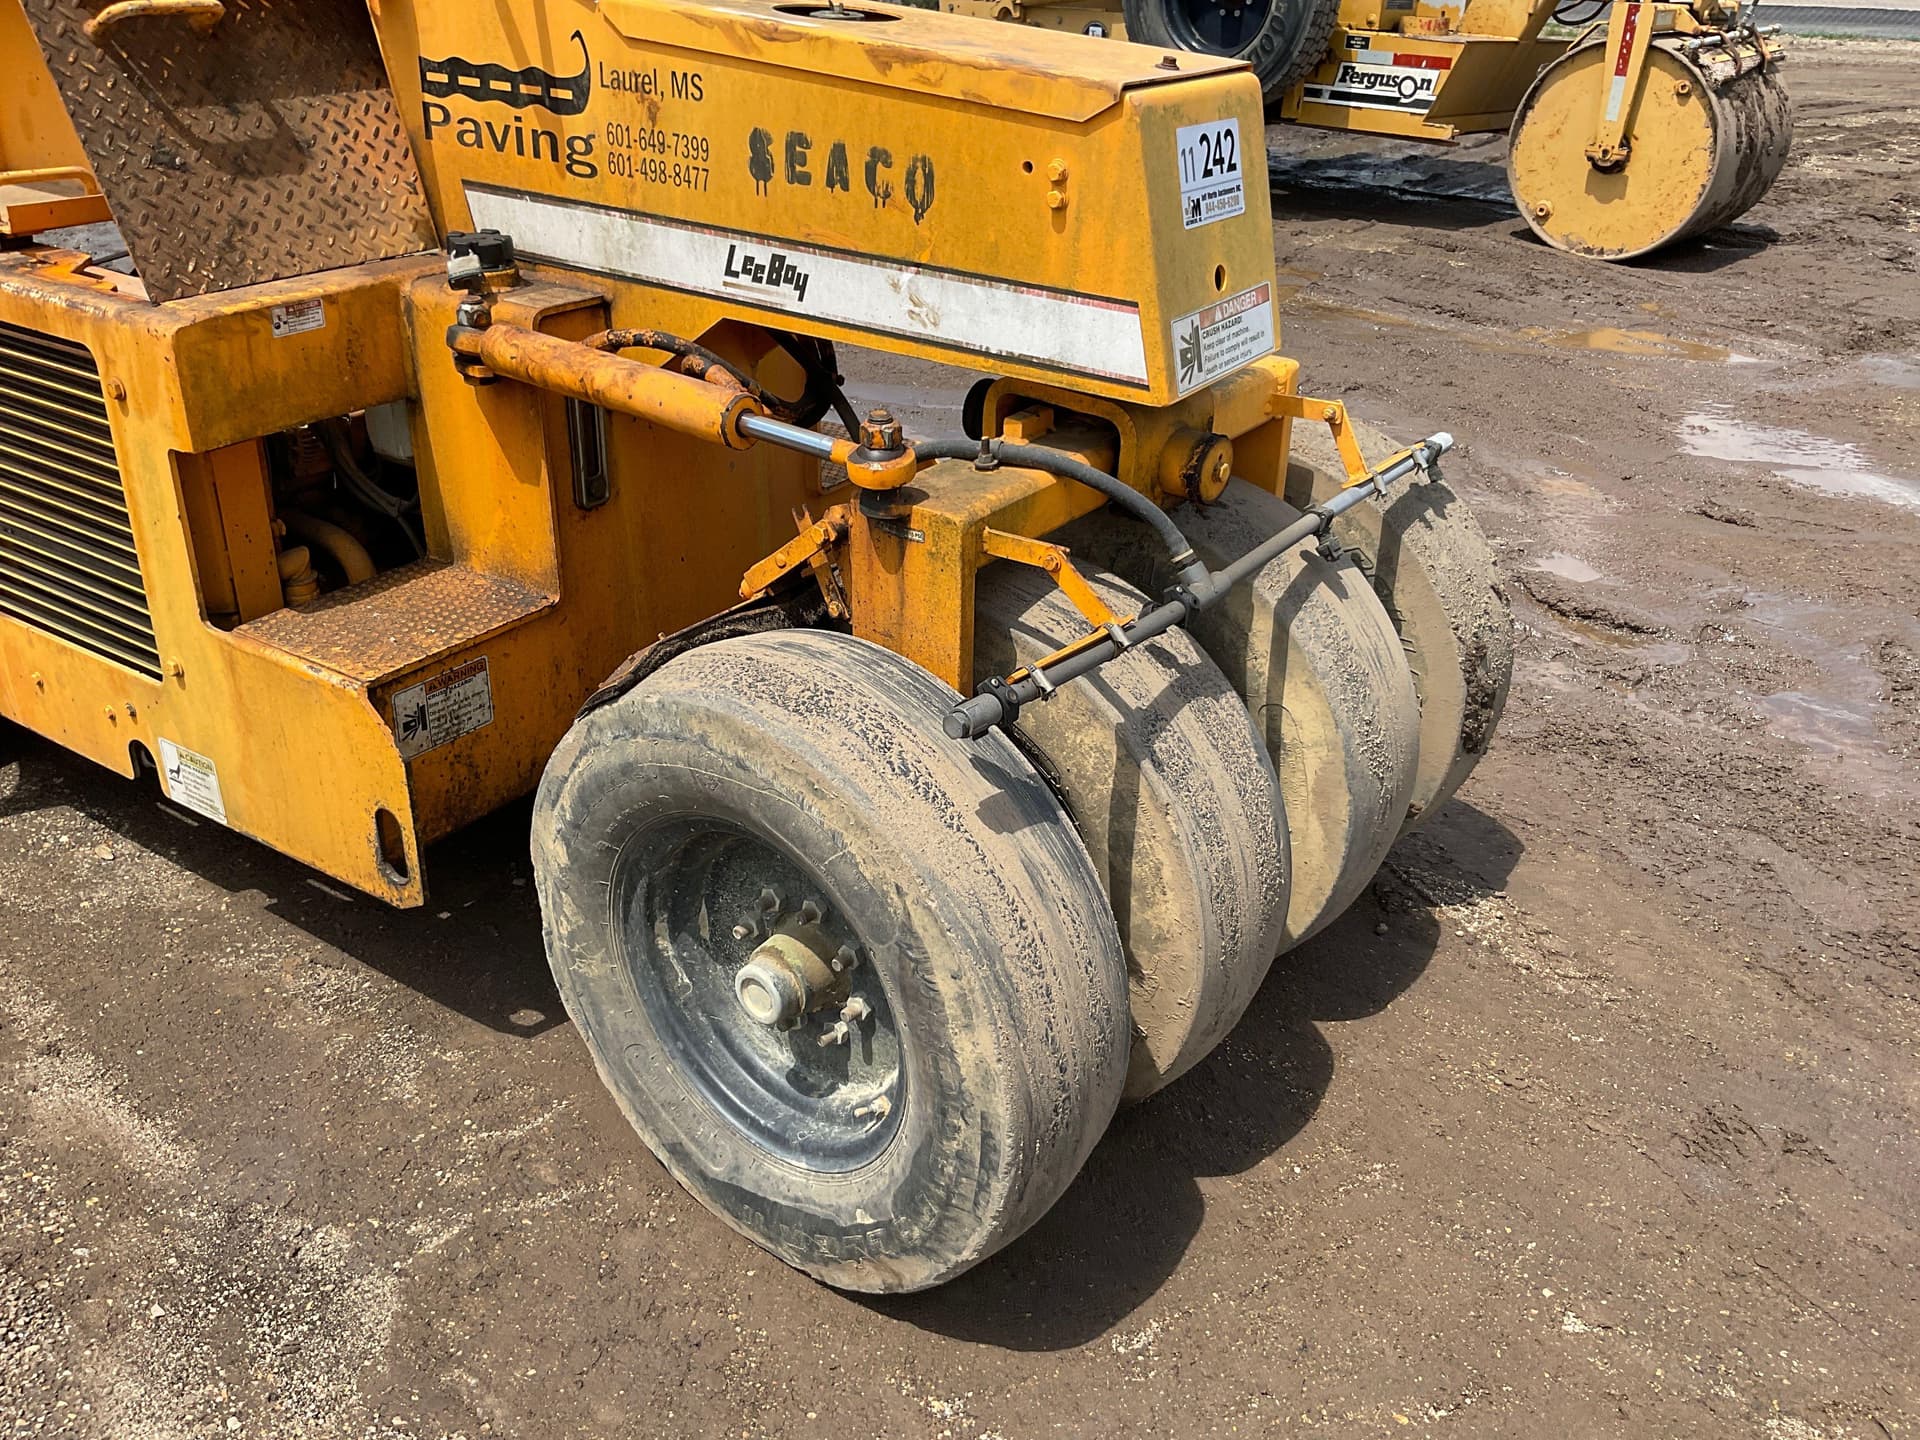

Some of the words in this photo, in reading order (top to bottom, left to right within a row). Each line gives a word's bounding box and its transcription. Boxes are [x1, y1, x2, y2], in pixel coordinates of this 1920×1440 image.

[599, 61, 665, 102] Laurel,
[671, 70, 704, 102] MS
[421, 101, 599, 179] Paving
[606, 122, 710, 162] 601-649-7399
[1181, 146, 1196, 184] 11
[1199, 128, 1237, 179] 242
[608, 151, 709, 192] 601-498-8477
[724, 244, 809, 302] LeeBoy
[1223, 291, 1257, 318] DANGER
[1202, 325, 1220, 339] CRUSH
[438, 662, 484, 688] WARNING
